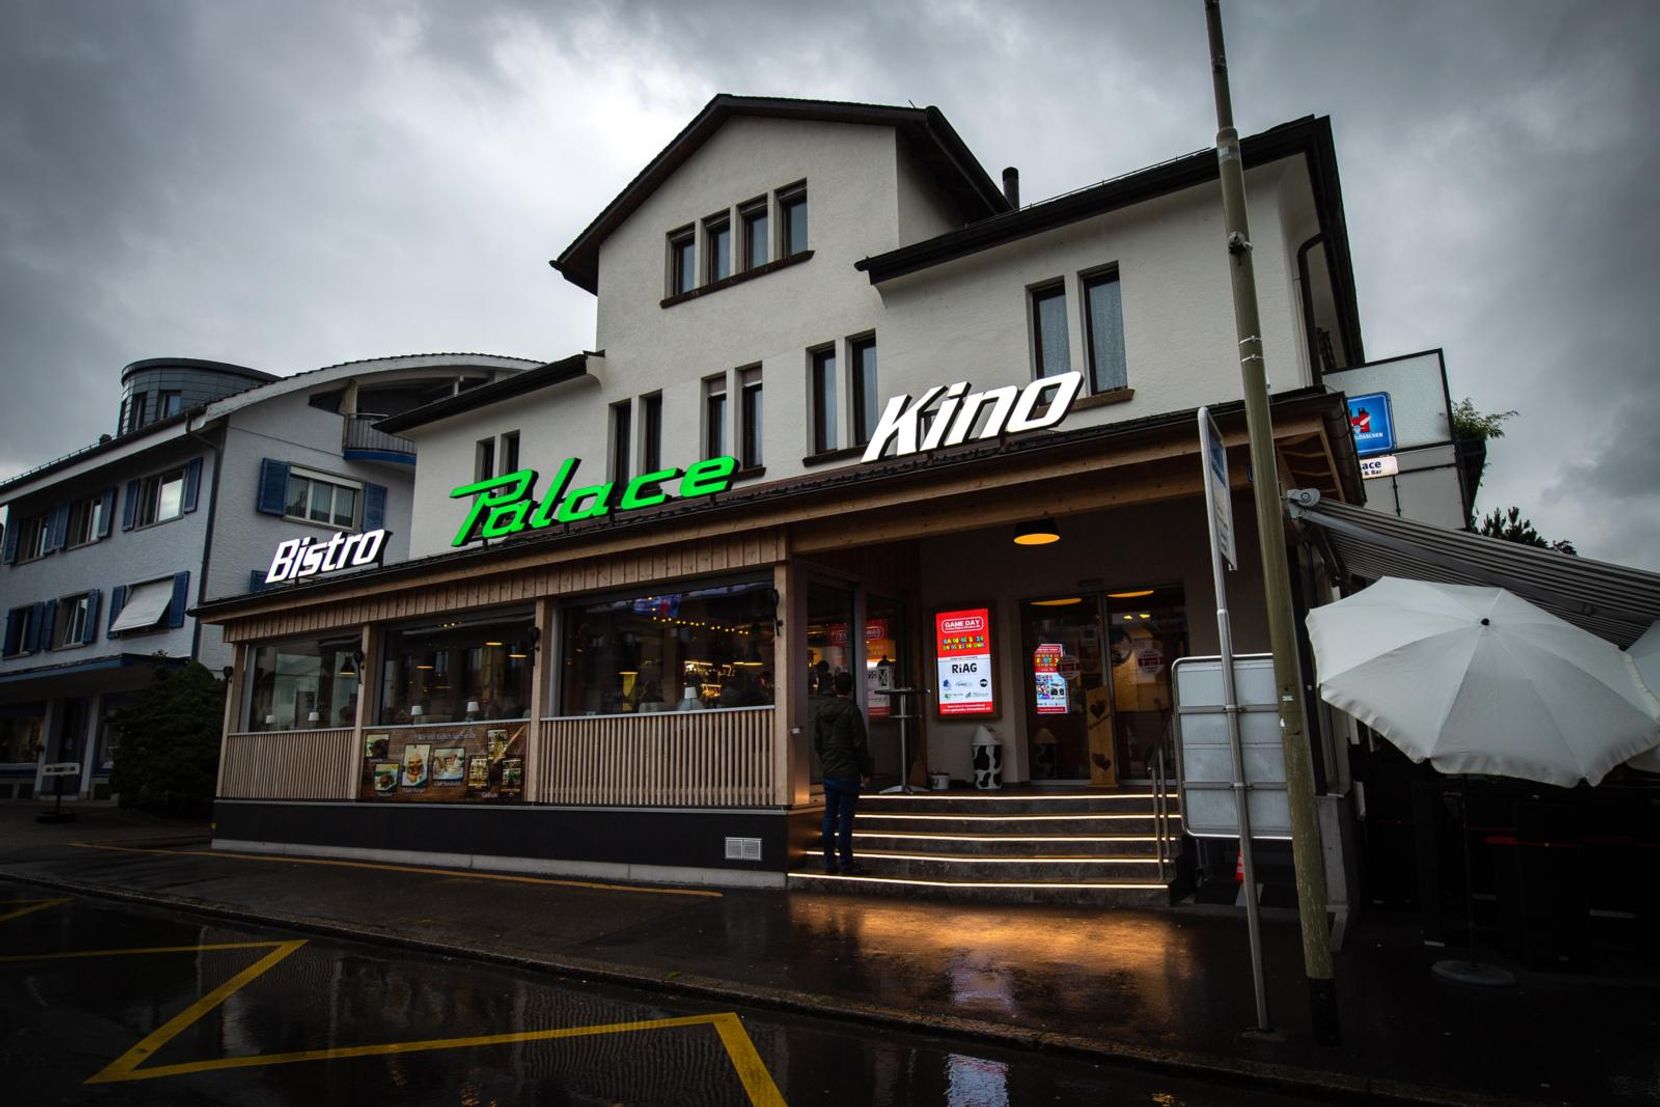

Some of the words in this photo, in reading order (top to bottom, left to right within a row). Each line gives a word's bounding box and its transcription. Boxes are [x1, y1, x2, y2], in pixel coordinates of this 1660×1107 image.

[861, 371, 1083, 463] Kino
[1362, 461, 1381, 470] ace
[450, 456, 738, 547] Palace
[265, 528, 388, 584] Bistro
[952, 662, 978, 674] RiAG
